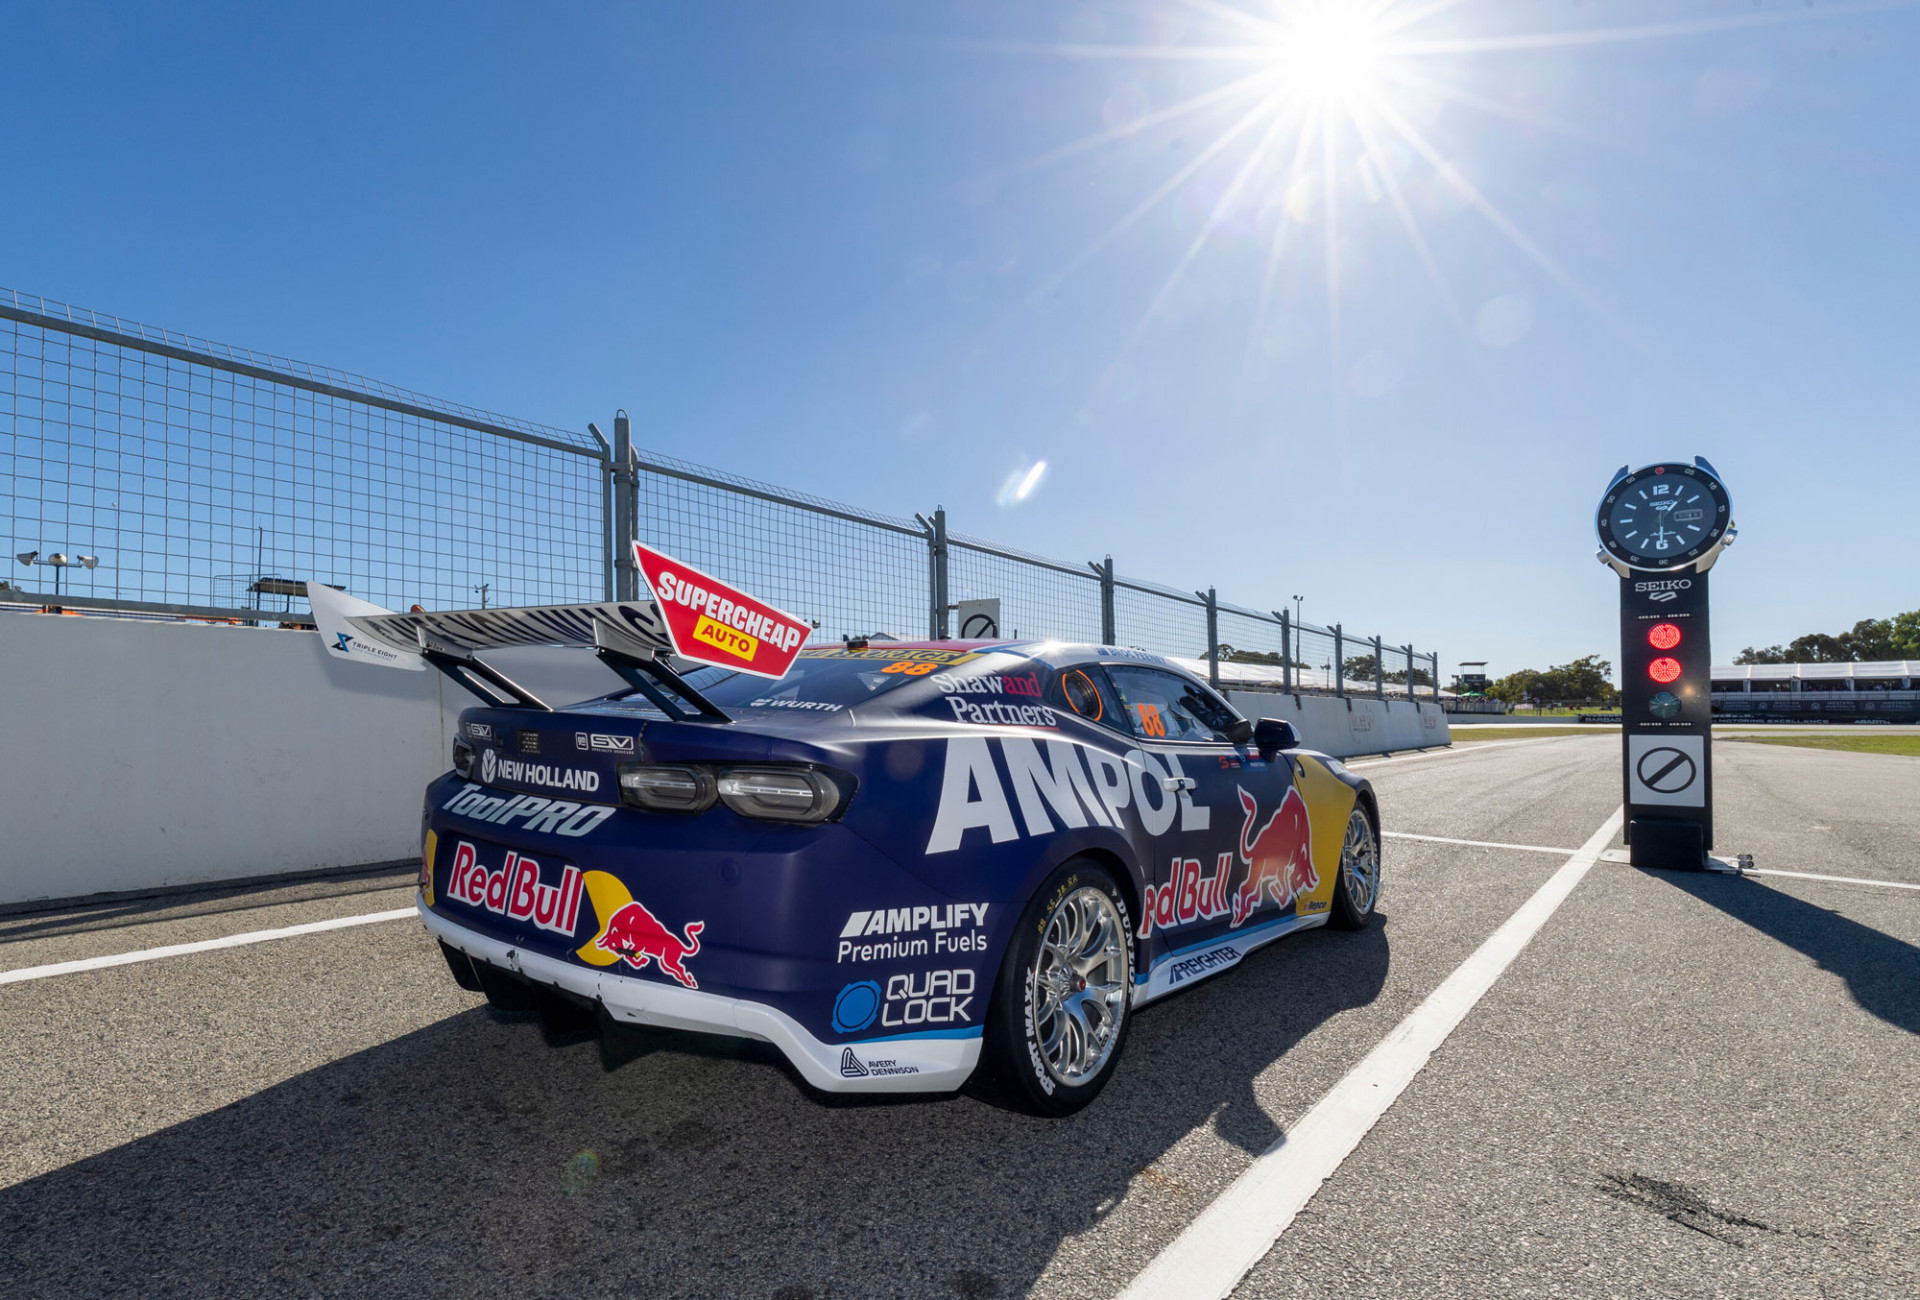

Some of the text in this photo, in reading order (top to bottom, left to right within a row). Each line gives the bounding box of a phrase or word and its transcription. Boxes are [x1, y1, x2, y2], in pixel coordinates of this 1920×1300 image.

[1652, 484, 1669, 496] 12
[1635, 579, 1692, 592] SEIKO
[657, 571, 801, 653] SUPERCHEAP
[353, 642, 398, 659] TRIPLE EIGHT
[702, 624, 750, 653] AUTO
[838, 650, 957, 662] STORAGE
[881, 662, 938, 675] 88
[945, 696, 1057, 726] Partners
[1137, 703, 1165, 737] 88
[498, 759, 599, 792] NEW HOLLAND
[442, 783, 617, 837] ToolPRO
[925, 736, 1210, 855] AMPOL
[447, 840, 584, 938] Red Bull
[1176, 852, 1233, 925] Bull
[864, 902, 989, 936] AMPLIFY
[837, 929, 987, 964] Premium Fuels
[1169, 946, 1241, 984] FREIGHTER
[886, 969, 975, 1000] QUAD
[881, 996, 974, 1027] LOCK
[1024, 966, 1056, 1096] SPORT MAXX
[868, 1059, 897, 1068] AVERY
[870, 1066, 919, 1076] DENNISON
